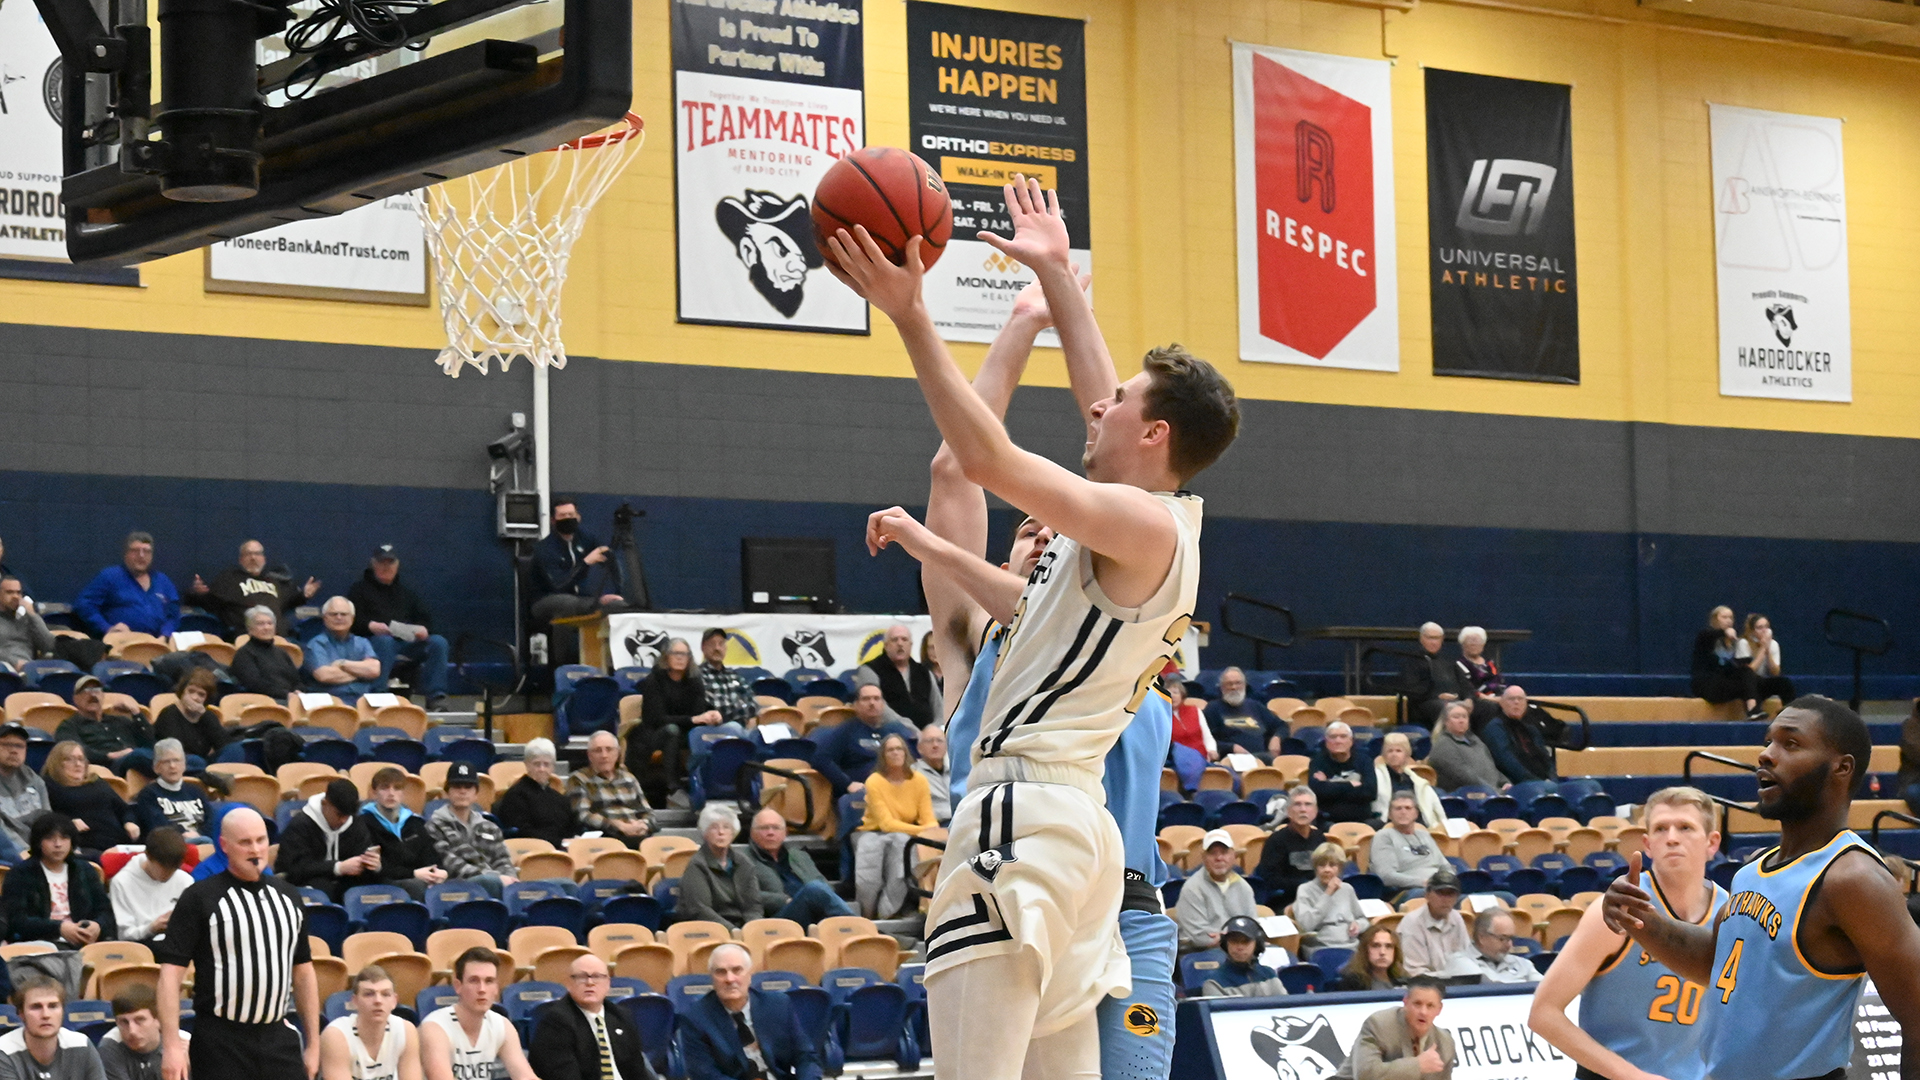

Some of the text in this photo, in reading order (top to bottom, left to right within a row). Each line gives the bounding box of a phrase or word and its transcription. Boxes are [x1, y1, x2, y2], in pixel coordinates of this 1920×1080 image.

[719, 16, 819, 48] Is Proud To
[708, 43, 776, 71] Partner
[931, 30, 1063, 70] INJURIES
[938, 66, 1058, 104] HAPPEN
[958, 106, 981, 117] HERE
[982, 109, 1010, 120] WHEN
[1010, 111, 1029, 122] YOU
[1029, 113, 1053, 124] NEED
[681, 100, 856, 161] TEAMMATES
[727, 147, 813, 166] MENTORING
[745, 164, 776, 175] RAPID
[778, 168, 801, 178] CITY
[956, 166, 1005, 179] WALK-IN
[953, 216, 977, 228] SAT.
[980, 218, 989, 229] 9
[1266, 208, 1368, 277] RESPEC
[1439, 248, 1565, 274] UNIVERSAL
[956, 276, 1032, 291] MONUME
[1442, 269, 1567, 293] ATHLETIC
[981, 292, 1017, 302] HEALT
[1738, 346, 1831, 373] HARDROCKER
[1761, 375, 1813, 388] ATHLETICS
[1716, 937, 1745, 1005] 4
[1648, 974, 1706, 1026] 20
